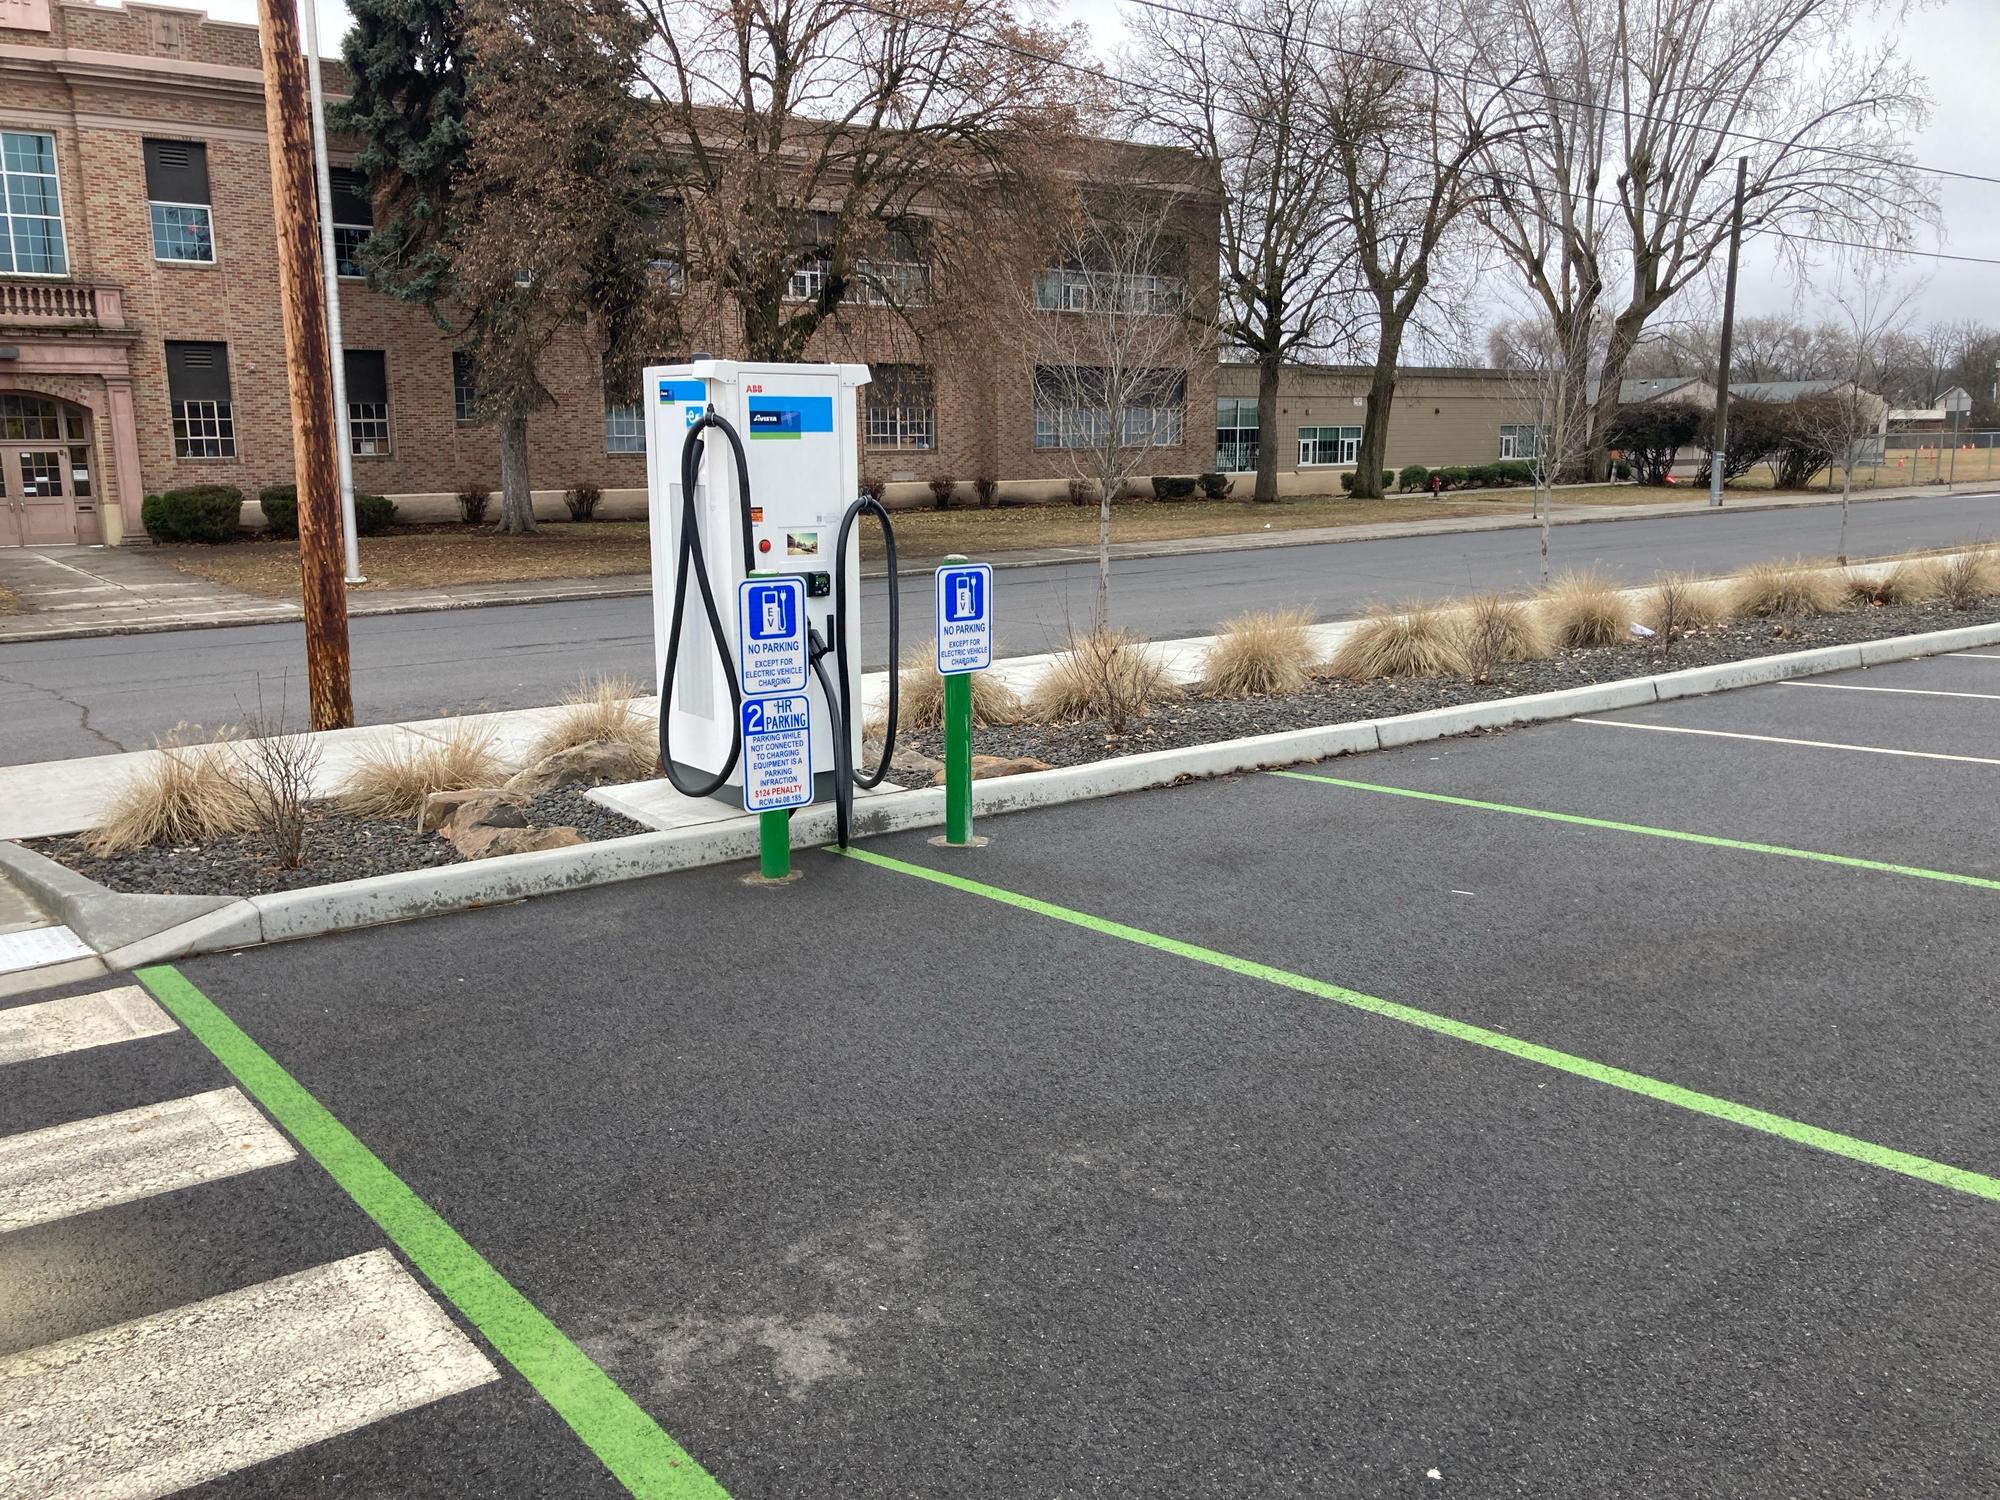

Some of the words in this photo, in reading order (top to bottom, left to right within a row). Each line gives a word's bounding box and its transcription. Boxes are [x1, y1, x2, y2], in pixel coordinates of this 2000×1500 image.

[746, 385, 763, 393] ABB
[944, 626, 954, 635] NO
[956, 623, 985, 634] PARKING
[748, 643, 760, 654] NO
[762, 641, 799, 653] PARKING
[949, 639, 969, 648] EXCEPT
[970, 638, 980, 646] FOR
[941, 648, 966, 658] ELECTRIC
[967, 646, 988, 656] VEHICLE
[755, 659, 778, 668] EXCEPT
[780, 658, 793, 667] FOR
[951, 656, 979, 666] CHARGING
[745, 668, 776, 679] ELECTRIC
[777, 666, 803, 676] VEHICLE
[758, 677, 791, 687] CHARGING
[776, 699, 792, 714] HR
[747, 704, 764, 732] 2
[766, 713, 806, 730] PARKING
[752, 733, 780, 743] PARKING
[781, 731, 802, 741] WHILE
[751, 744, 764, 752] NOT
[765, 740, 804, 751] CONNECTED
[756, 753, 765, 761] TO
[766, 749, 799, 760] CHARGING
[753, 759, 789, 770] EQUIPMENT
[764, 768, 793, 777] PARKING
[760, 776, 798, 787] INFRACTION
[755, 788, 770, 798] $124
[772, 785, 802, 796] PENALTY
[759, 797, 775, 806] RCW
